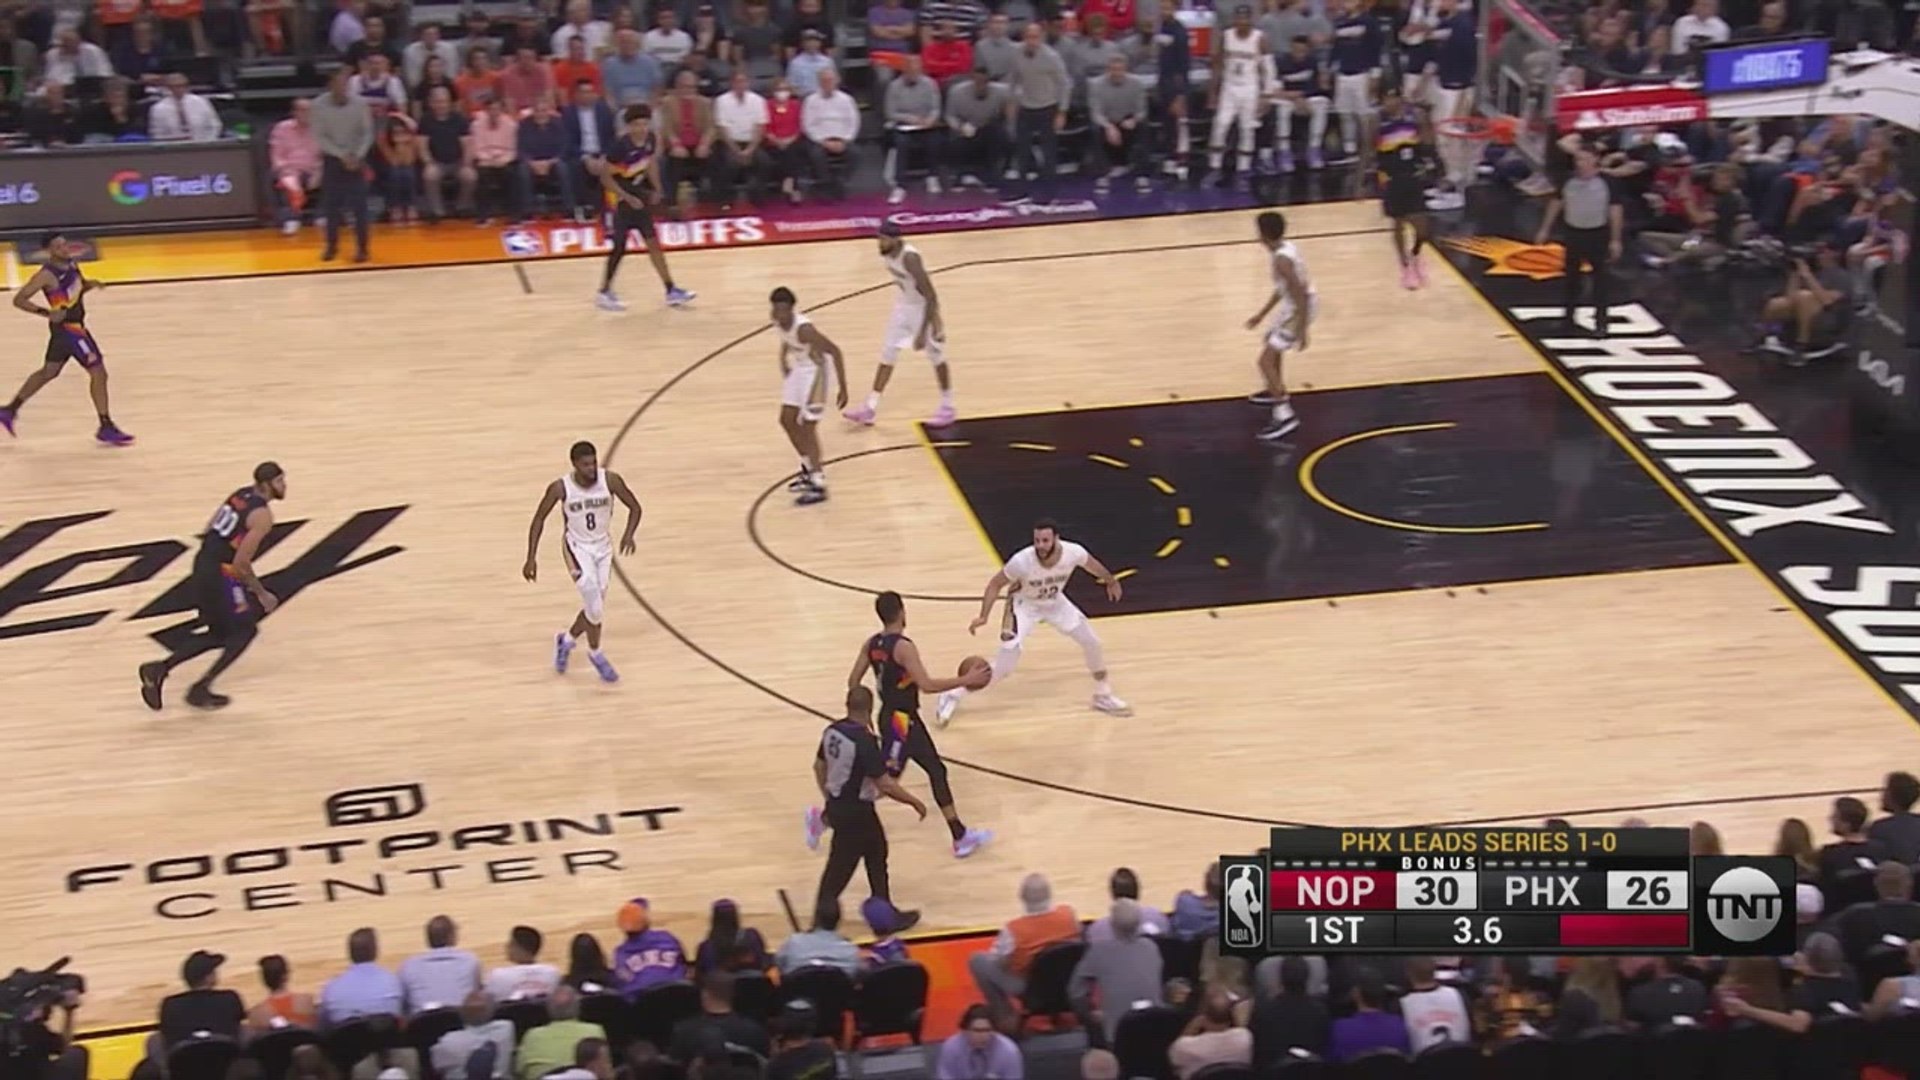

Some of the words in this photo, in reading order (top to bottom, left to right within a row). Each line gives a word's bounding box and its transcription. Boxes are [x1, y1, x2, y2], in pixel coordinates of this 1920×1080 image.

[19, 182, 40, 203] 6
[152, 175, 211, 196] Pixel
[213, 173, 232, 194] 6
[1509, 303, 1895, 536] PHOENIX
[585, 512, 597, 532] 8
[66, 807, 682, 893] FOOTPRINT
[155, 849, 626, 919] CENTER
